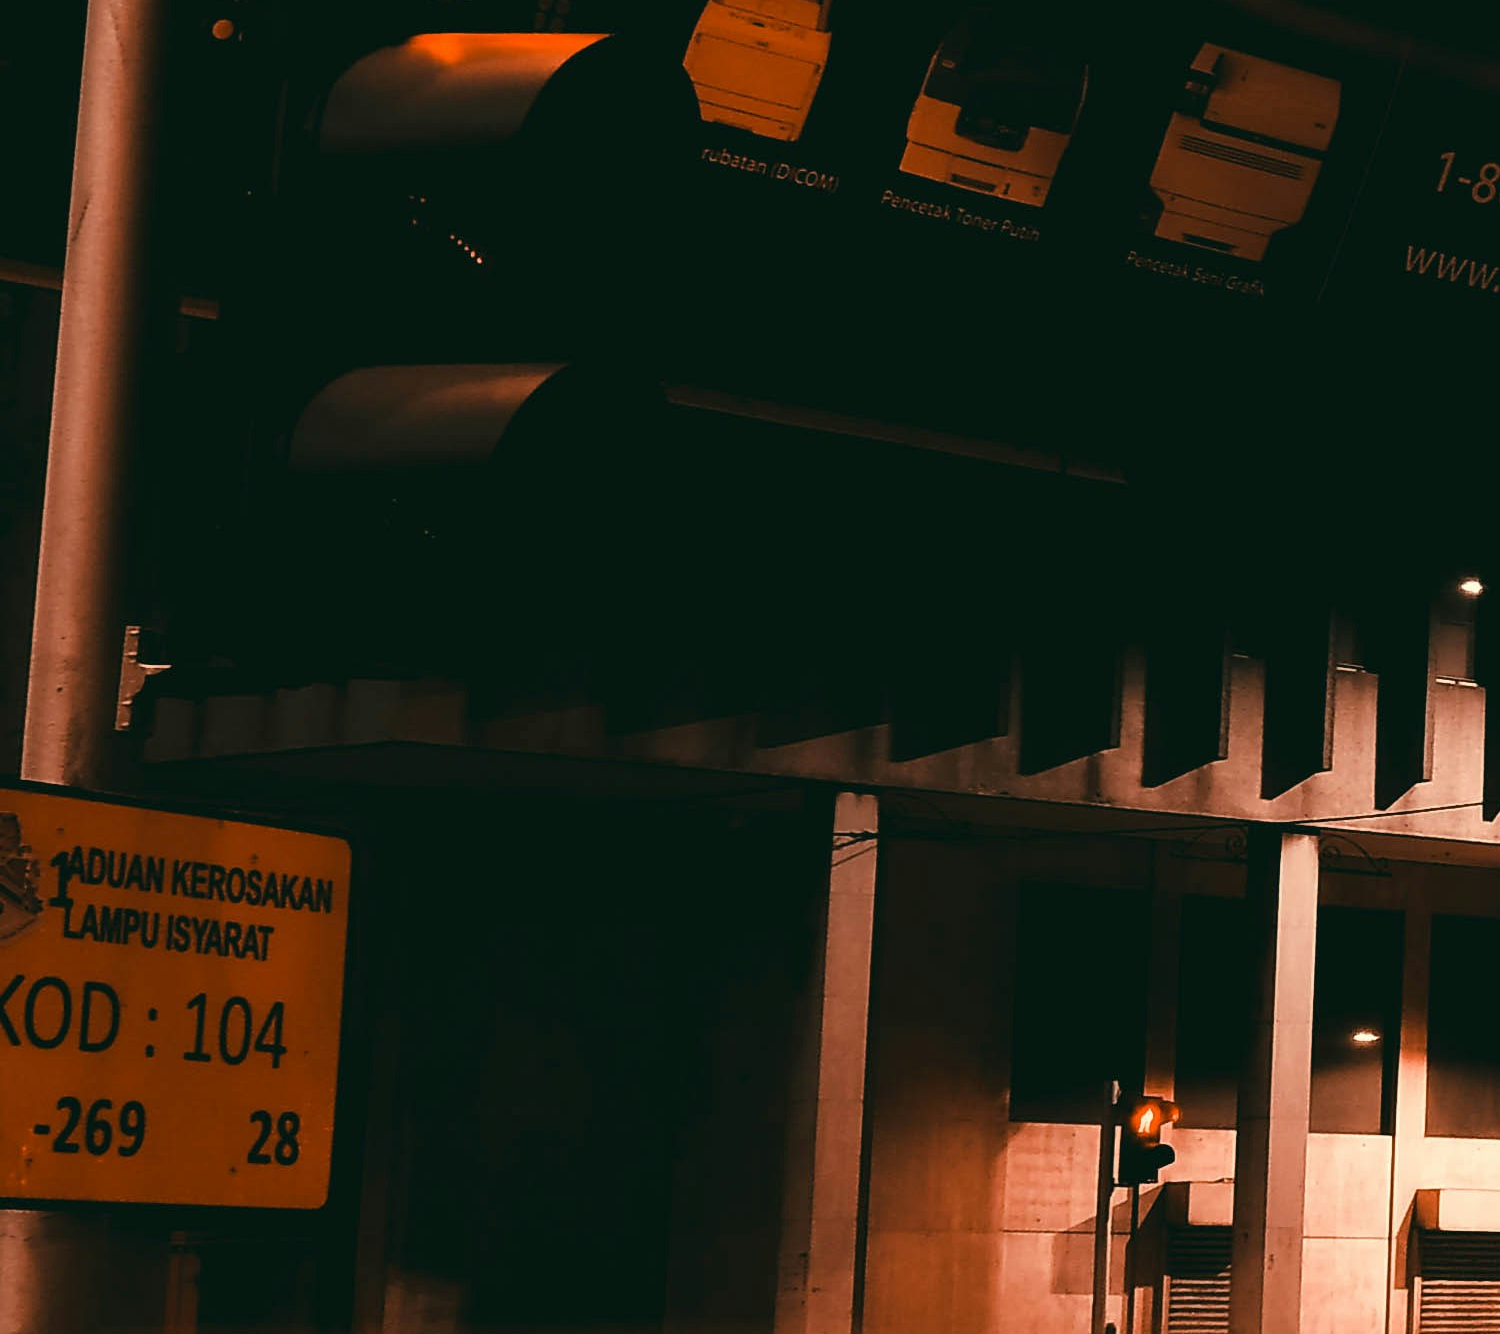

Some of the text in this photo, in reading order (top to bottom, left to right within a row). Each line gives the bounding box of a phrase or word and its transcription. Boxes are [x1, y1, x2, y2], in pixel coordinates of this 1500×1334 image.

[881, 188, 951, 220] Pencetak
[68, 846, 165, 895] ADUAN
[172, 860, 334, 915] KEROSAKAN
[64, 905, 274, 962] LAMPU ISYARAT
[183, 992, 288, 1069] 104
[247, 1109, 301, 1166] 28
